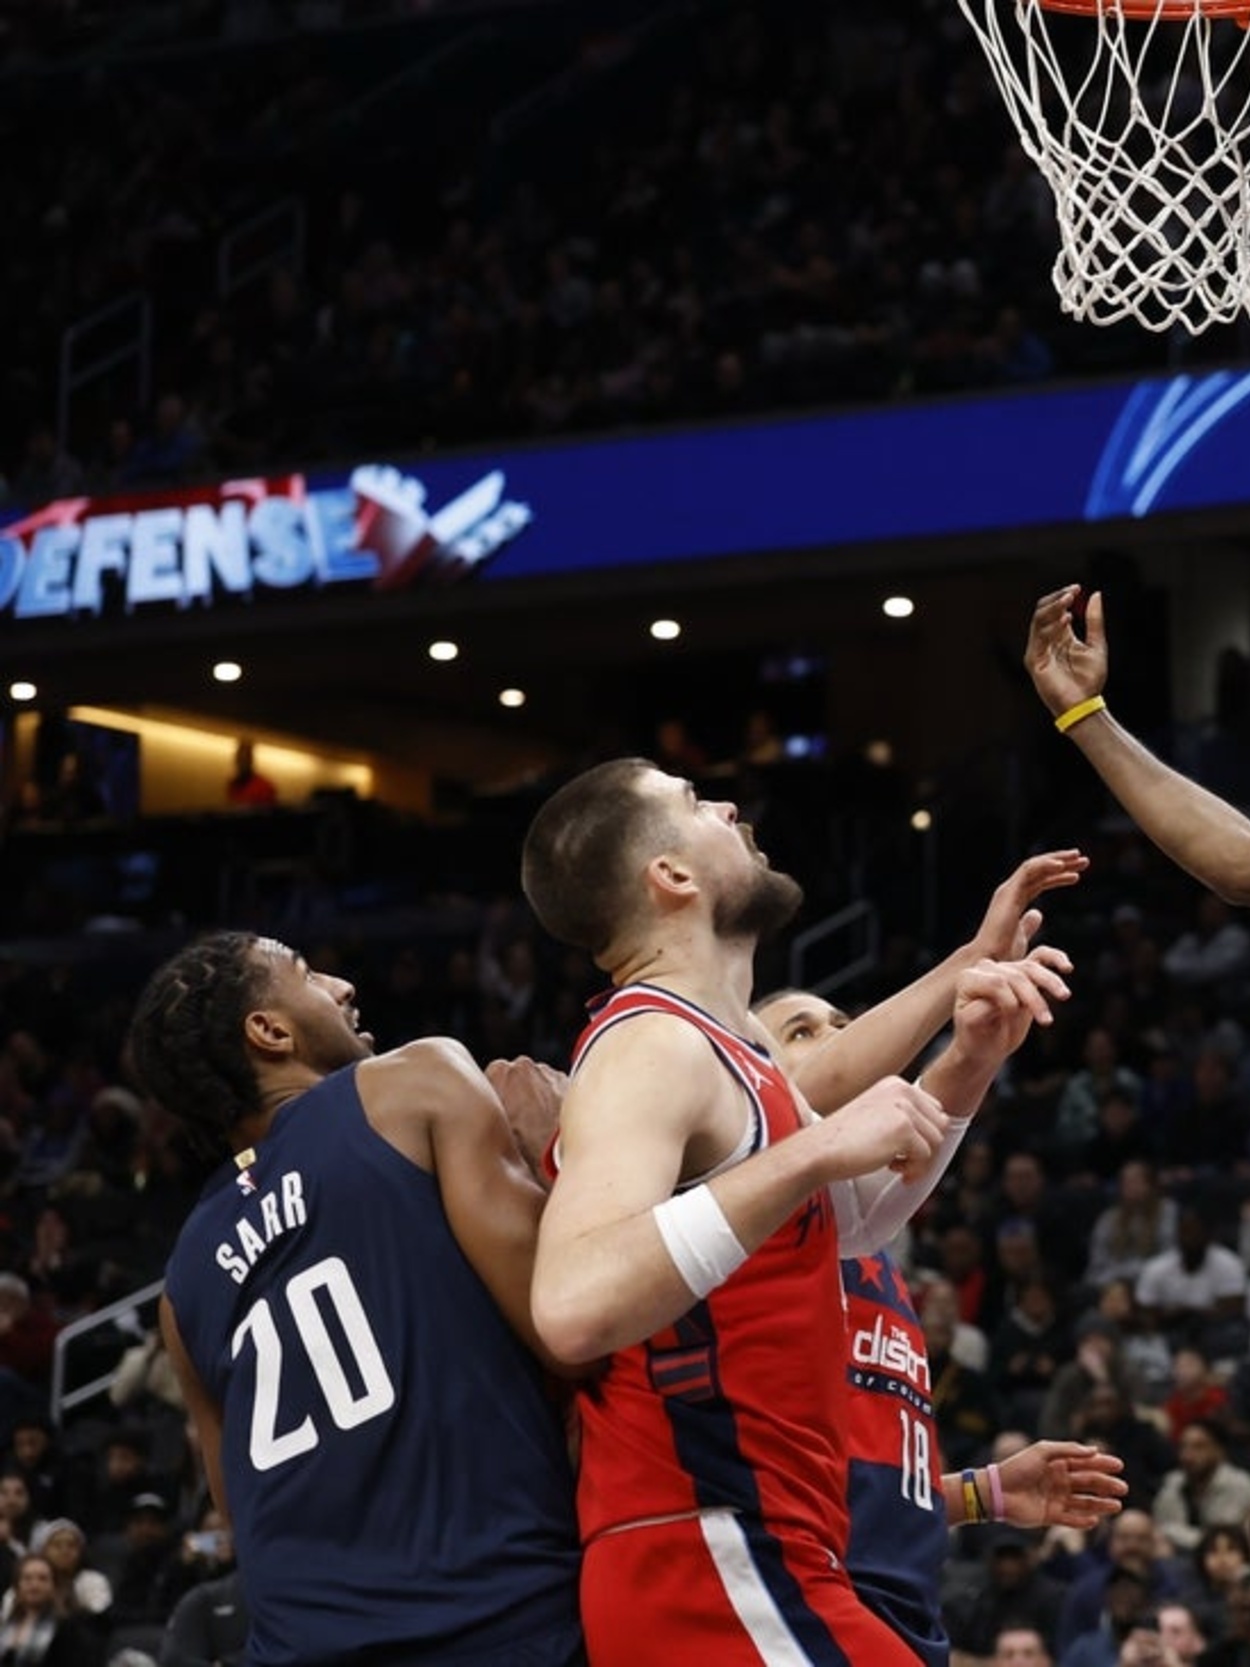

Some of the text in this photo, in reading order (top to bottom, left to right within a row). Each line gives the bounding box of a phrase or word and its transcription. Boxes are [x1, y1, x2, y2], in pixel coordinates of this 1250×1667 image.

[216, 1171, 307, 1284] SARR
[231, 1256, 395, 1471] 20
[900, 1409, 933, 1512] 18
